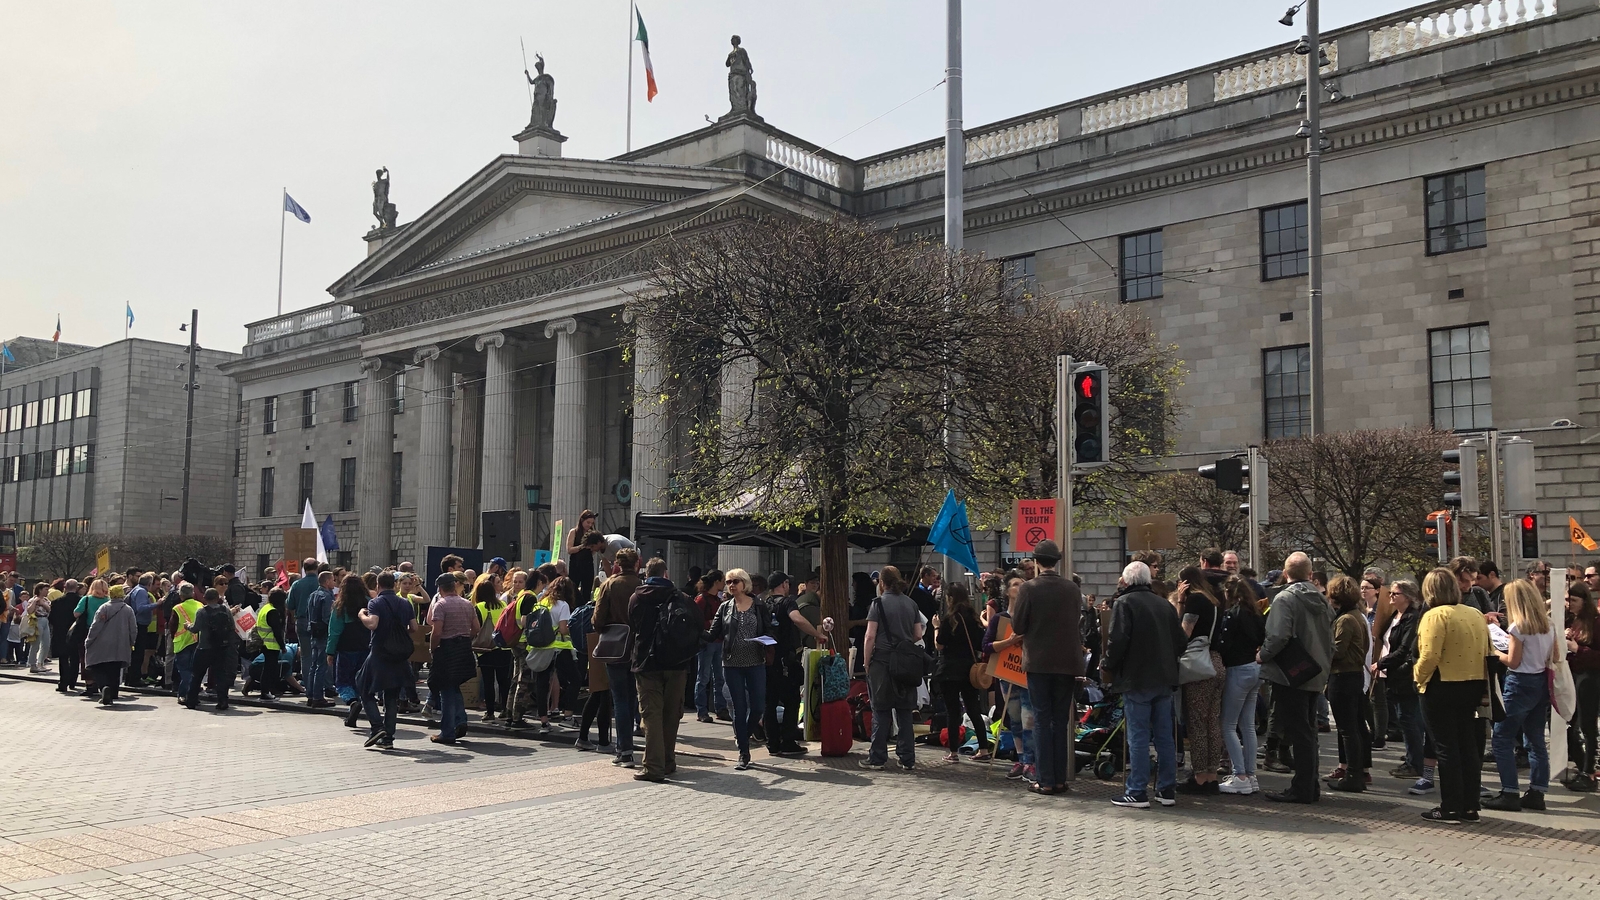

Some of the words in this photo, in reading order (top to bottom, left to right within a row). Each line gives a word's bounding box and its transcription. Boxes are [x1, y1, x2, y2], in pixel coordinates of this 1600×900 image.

[1021, 507, 1037, 515] TELL
[1040, 507, 1054, 515] THE
[1025, 516, 1049, 524] TRUTH
